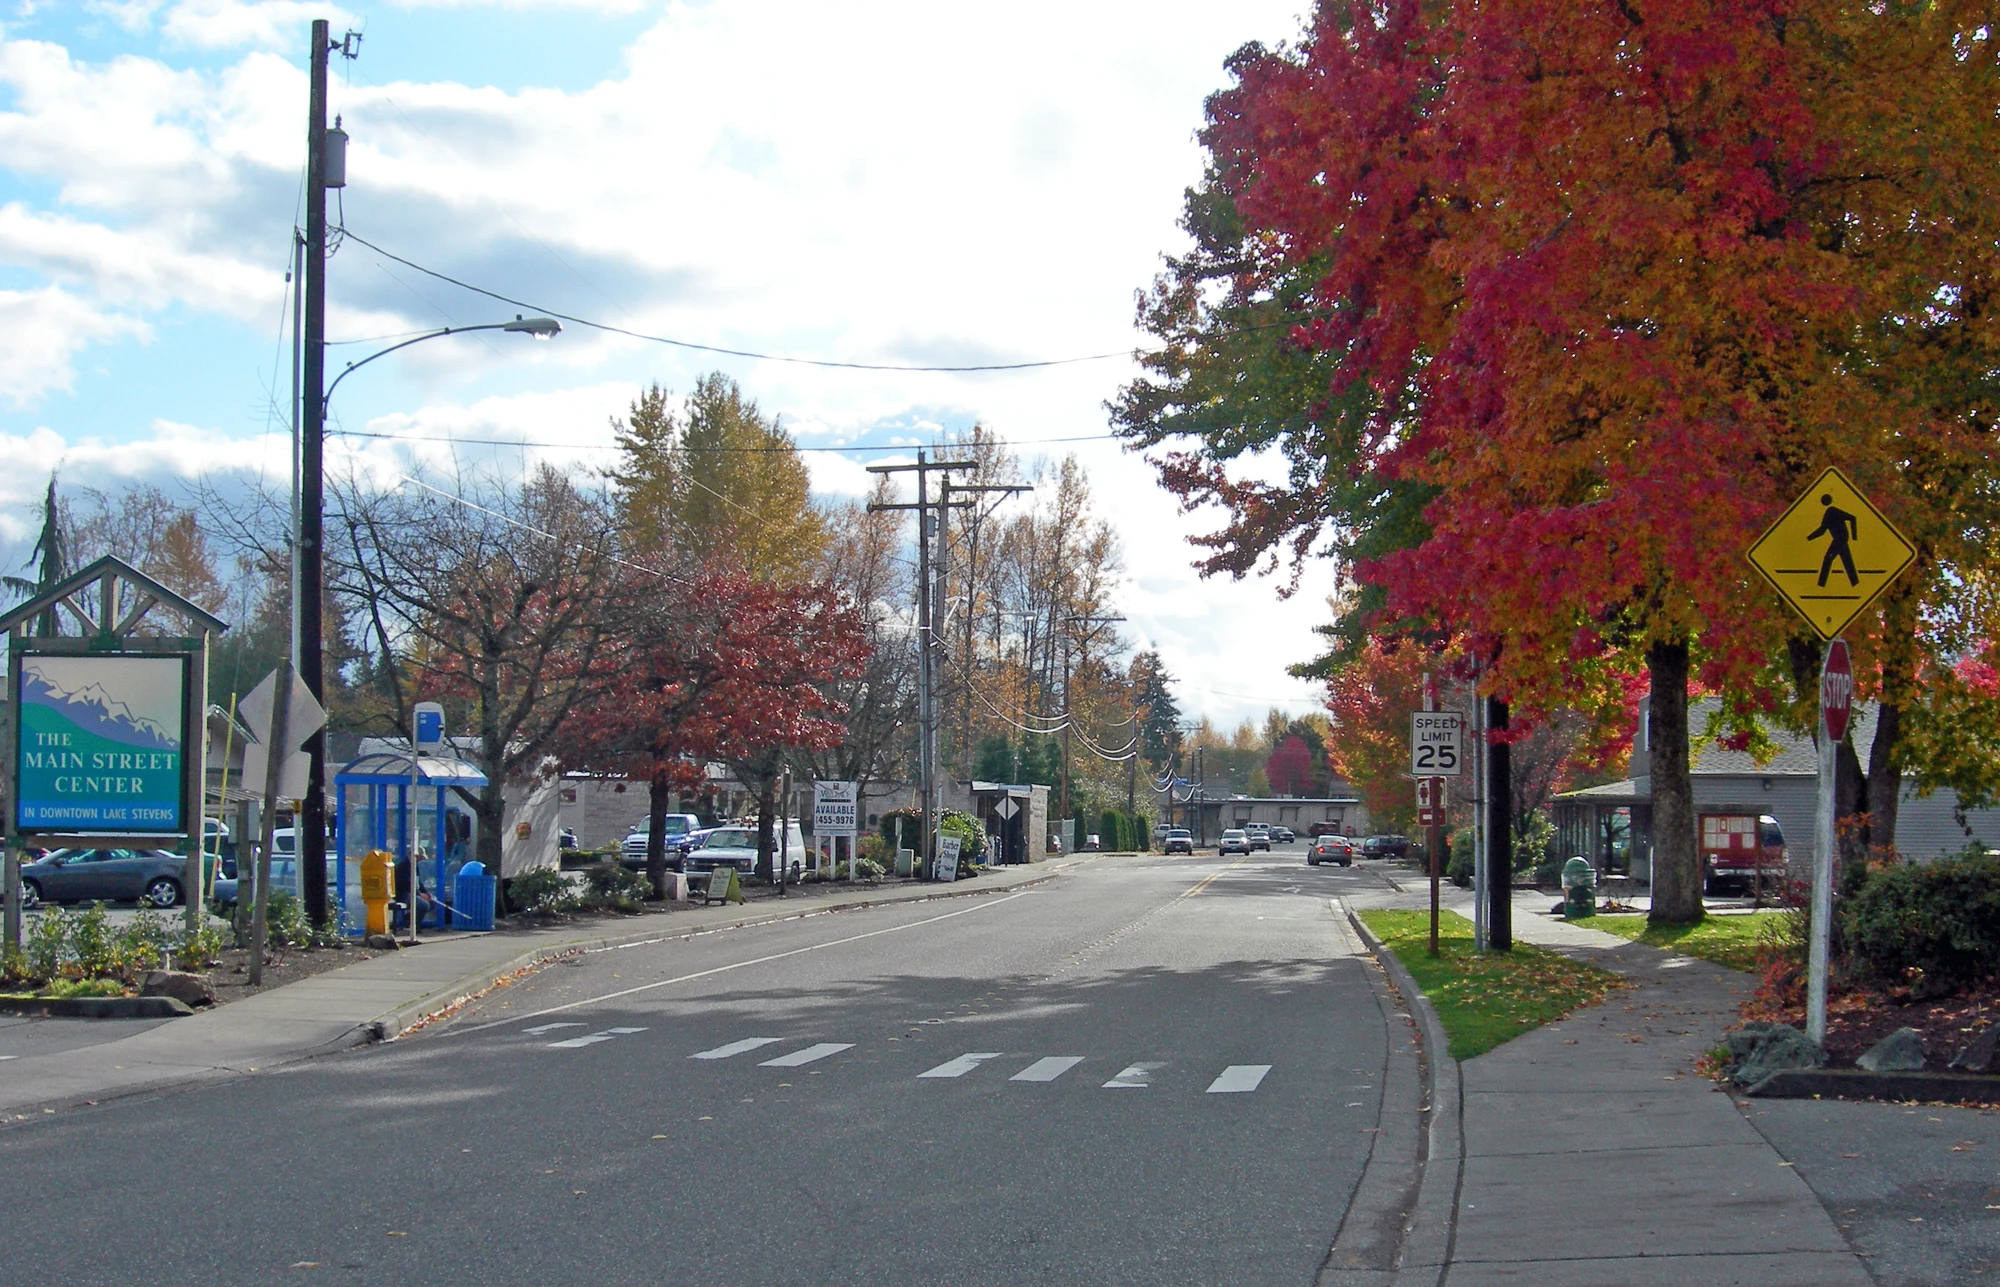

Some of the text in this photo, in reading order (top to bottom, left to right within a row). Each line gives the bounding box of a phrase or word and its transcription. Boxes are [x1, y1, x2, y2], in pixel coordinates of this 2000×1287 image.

[1824, 672, 1850, 709] STOP
[1416, 718, 1459, 729] SPEED
[36, 732, 72, 746] THE
[1421, 732, 1453, 742] LIMIT
[25, 752, 176, 770] MAIN STREET
[1416, 744, 1457, 769] 25
[54, 776, 144, 794] CENTER
[24, 807, 174, 820] IN DOWNTOWN LAKE STEVENS
[815, 805, 855, 815] AVAILABLE
